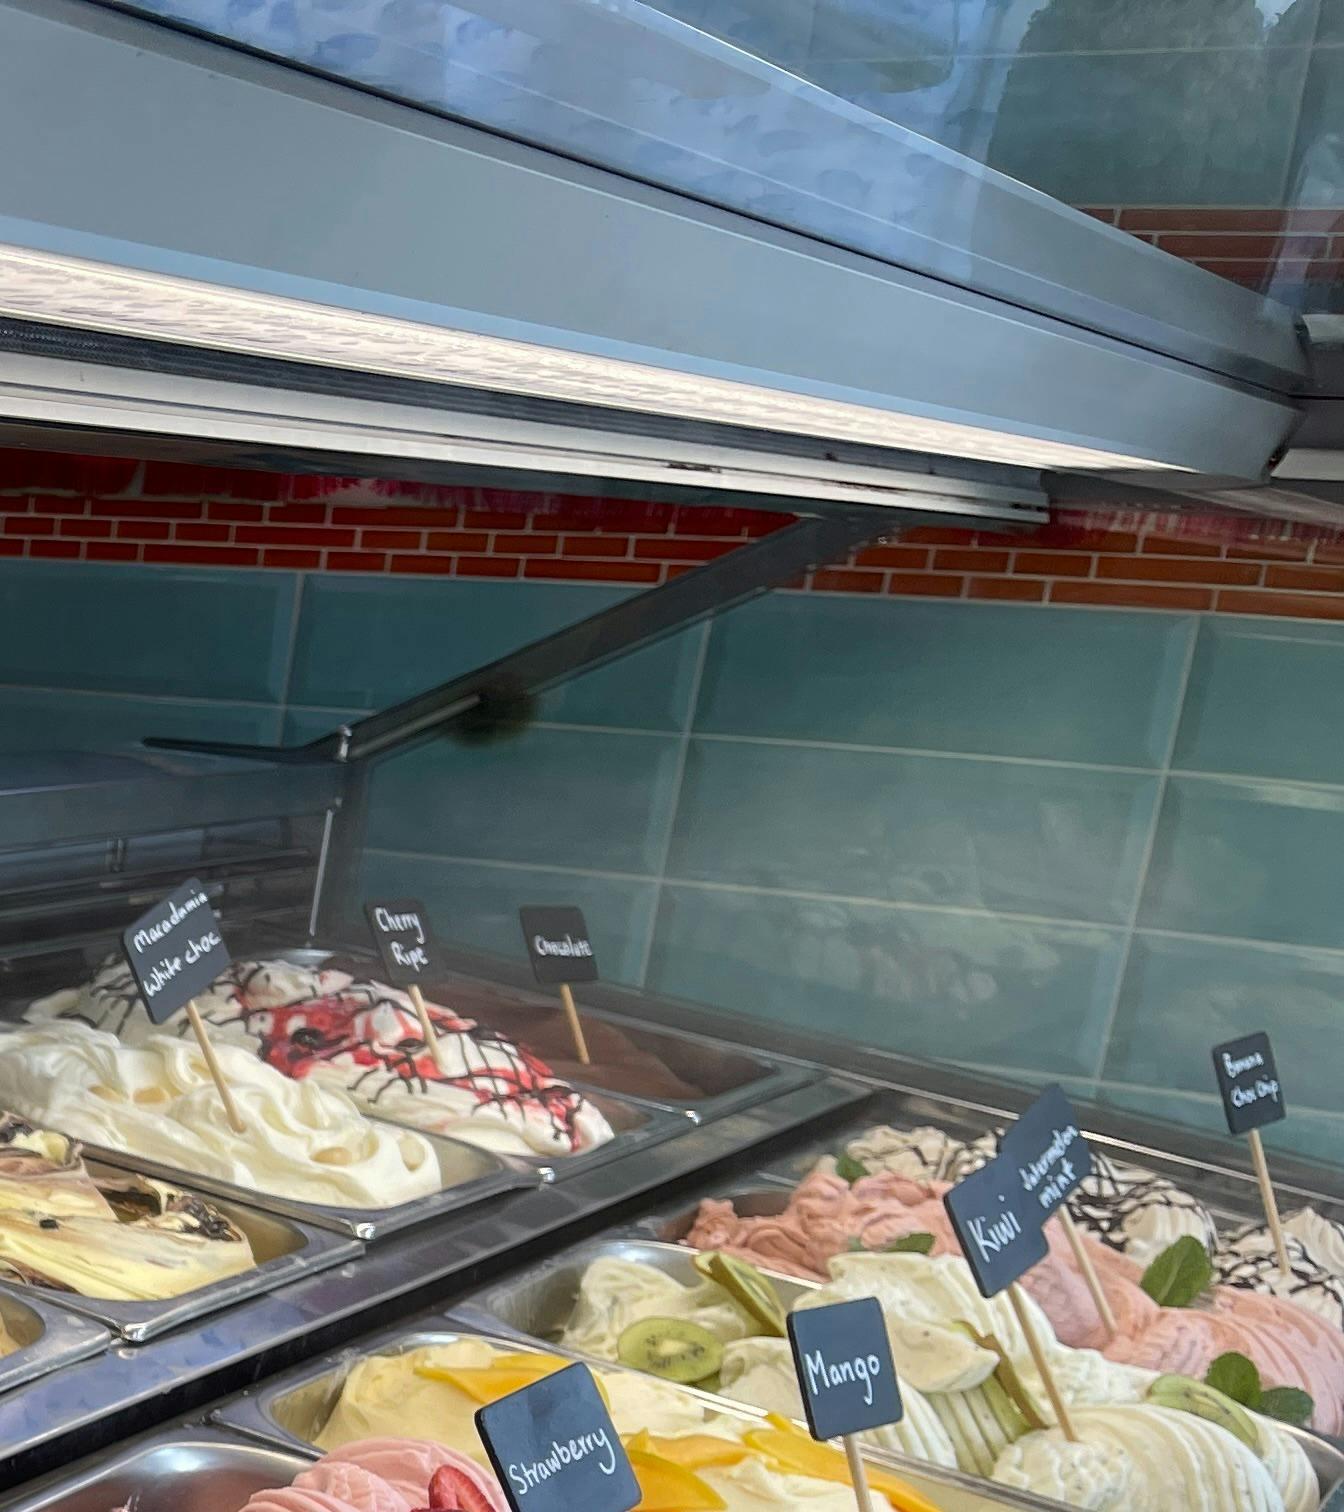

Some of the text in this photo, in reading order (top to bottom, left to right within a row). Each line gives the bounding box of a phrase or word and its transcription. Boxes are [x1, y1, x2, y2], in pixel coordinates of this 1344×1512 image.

[133, 889, 208, 953] Macadamia
[375, 907, 424, 944] Cherry
[144, 958, 183, 997] White
[390, 941, 429, 973] Ripe
[967, 1195, 1022, 1263] Kiwi
[805, 1350, 880, 1405] Mango
[509, 1428, 616, 1495] Strawberry
